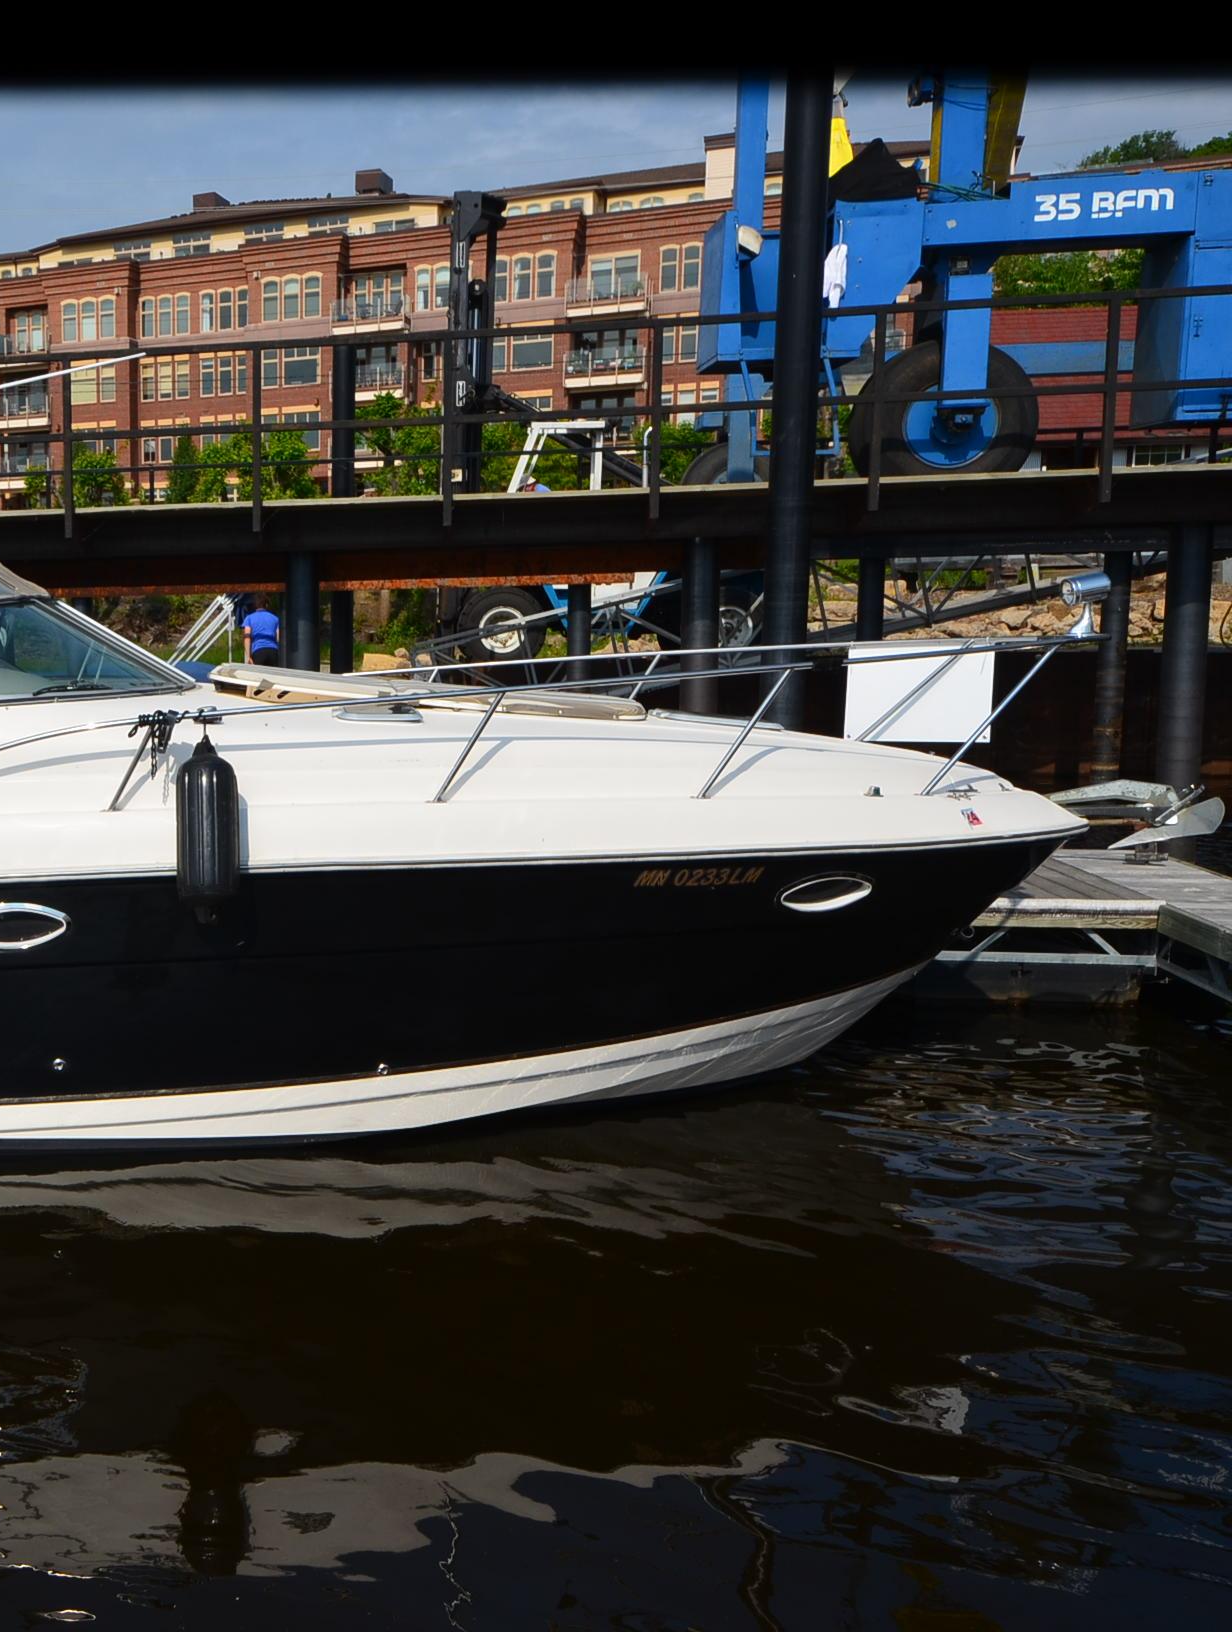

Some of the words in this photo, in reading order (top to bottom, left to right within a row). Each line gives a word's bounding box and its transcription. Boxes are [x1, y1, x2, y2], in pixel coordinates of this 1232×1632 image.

[1034, 192, 1081, 222] 35
[633, 869, 671, 888] MN
[673, 866, 766, 887] 0233LM
